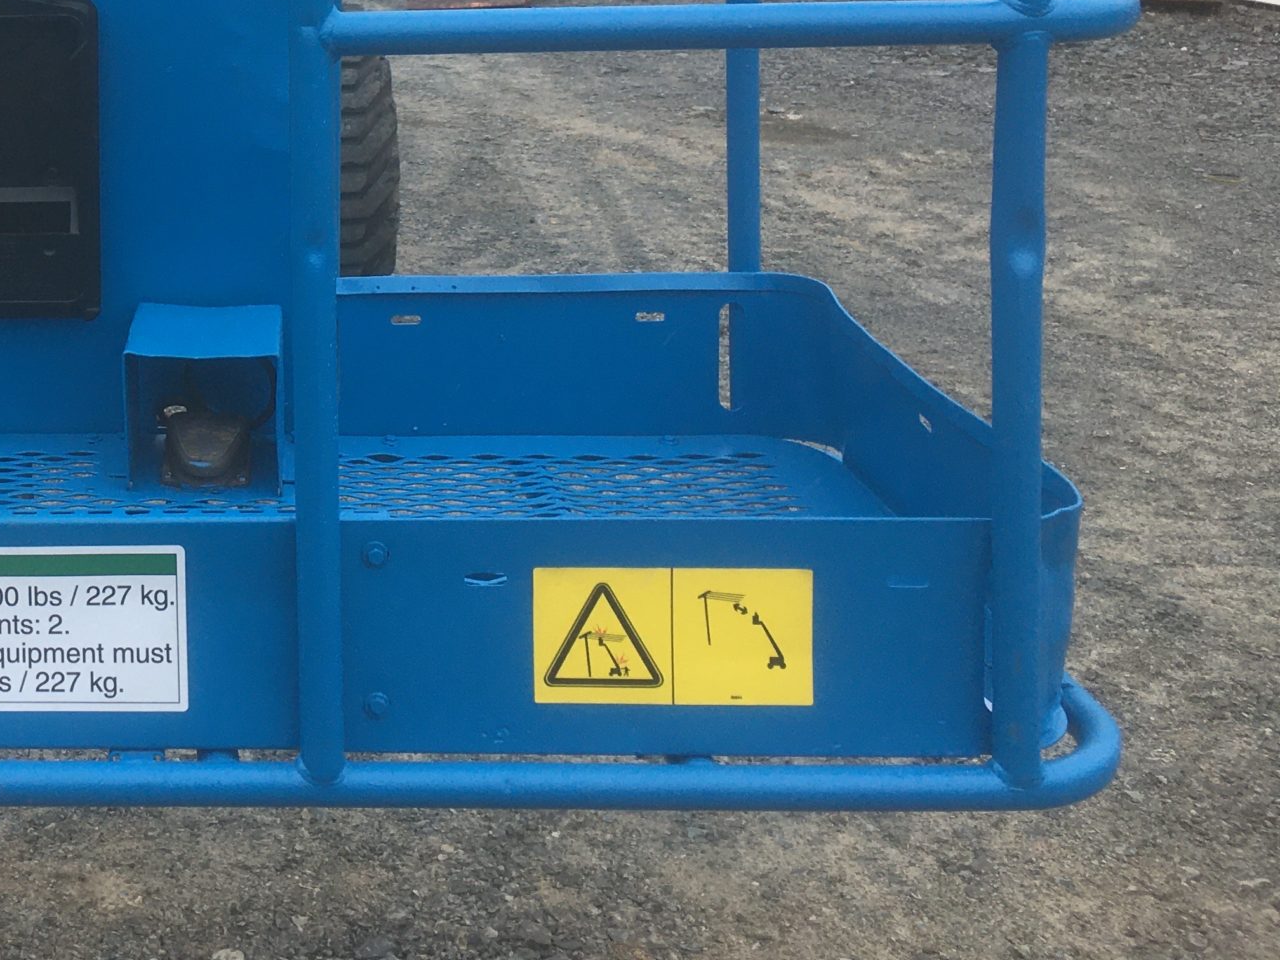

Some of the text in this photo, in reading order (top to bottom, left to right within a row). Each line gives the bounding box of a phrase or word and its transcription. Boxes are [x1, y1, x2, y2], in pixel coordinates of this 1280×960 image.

[28, 585, 63, 607] lbs
[85, 585, 132, 606] 227
[141, 584, 175, 611] kg.
[48, 614, 70, 635] 2.
[113, 643, 172, 664] must
[35, 671, 81, 693] 227
[90, 670, 124, 699] kg.
